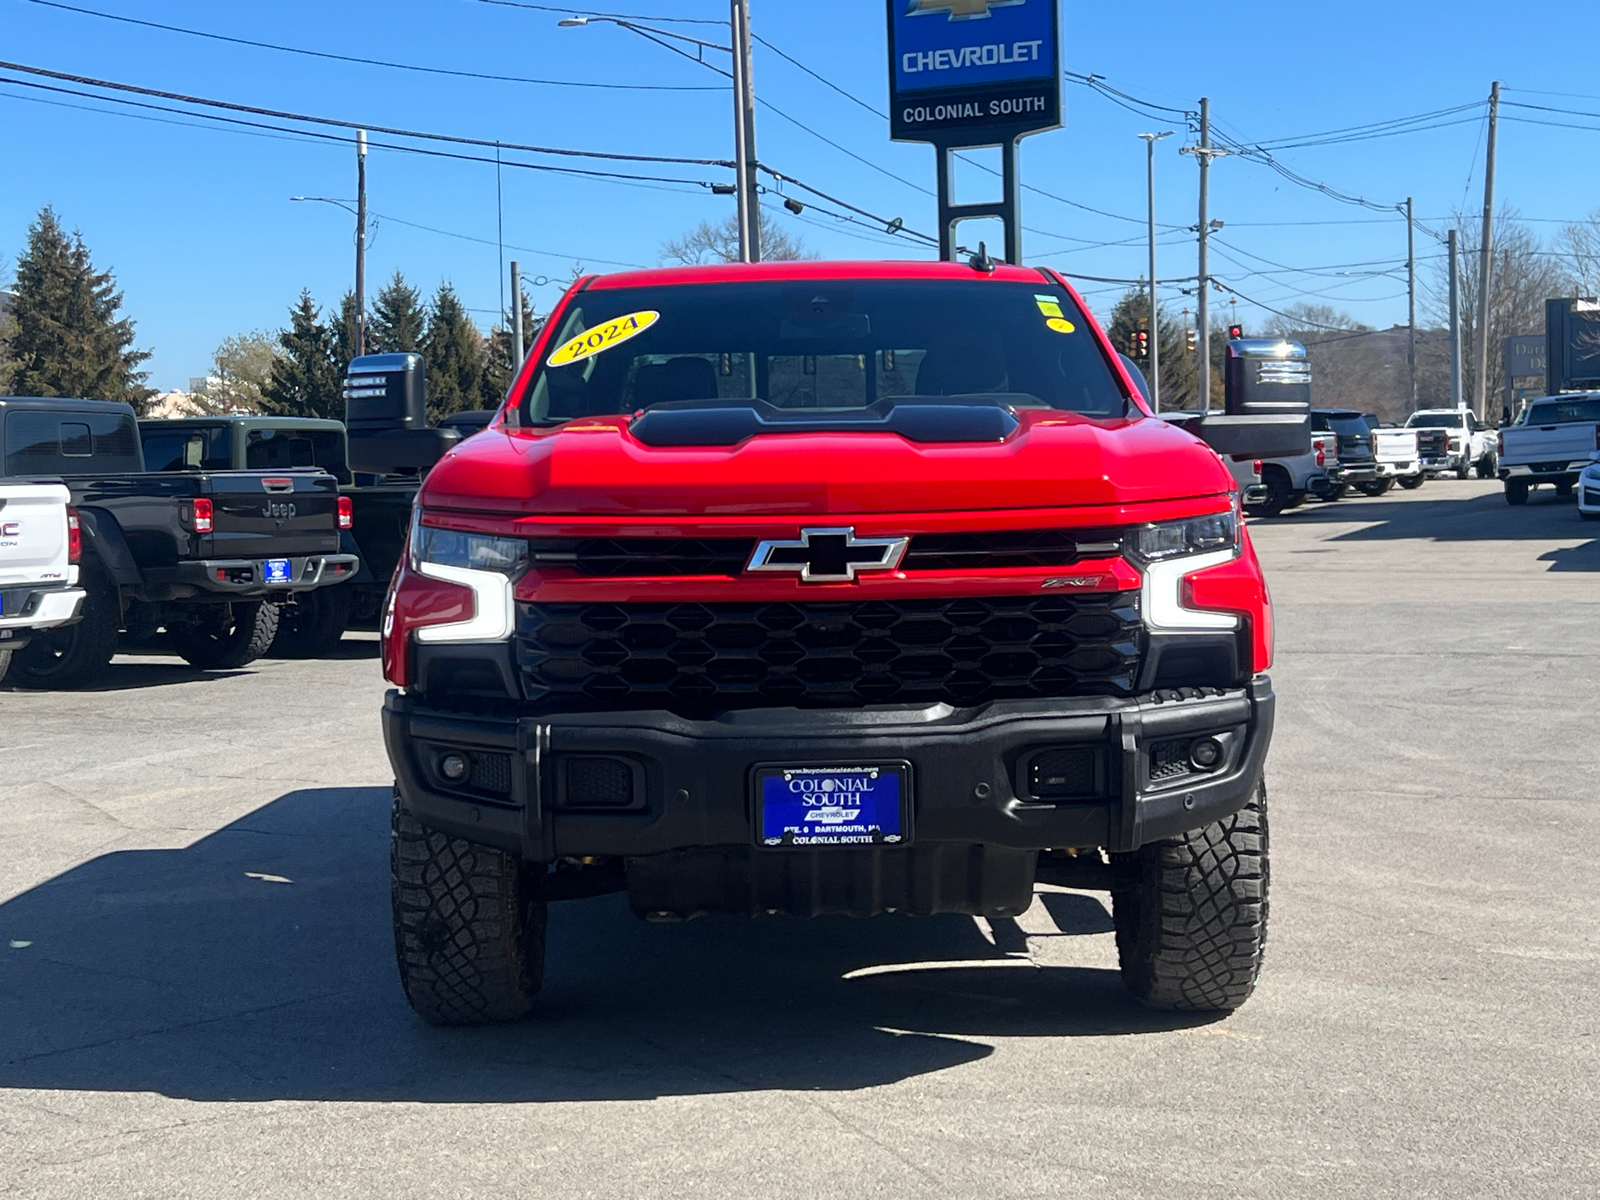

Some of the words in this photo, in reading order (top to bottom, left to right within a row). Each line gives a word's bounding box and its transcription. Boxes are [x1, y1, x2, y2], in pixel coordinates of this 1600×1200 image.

[902, 40, 1043, 73] CHEVROLET
[903, 103, 984, 123] COLONIAL
[989, 96, 1045, 116] SOUTH
[569, 316, 639, 358] 2024
[262, 500, 296, 520] Jeep
[789, 778, 874, 793] COLONIAL
[802, 792, 861, 806] SOUTH
[810, 811, 855, 819] CHEVROLET
[815, 825, 867, 833] DARTMOUTH,
[792, 836, 840, 845] COLONIAL
[841, 835, 873, 844] SOUTH
